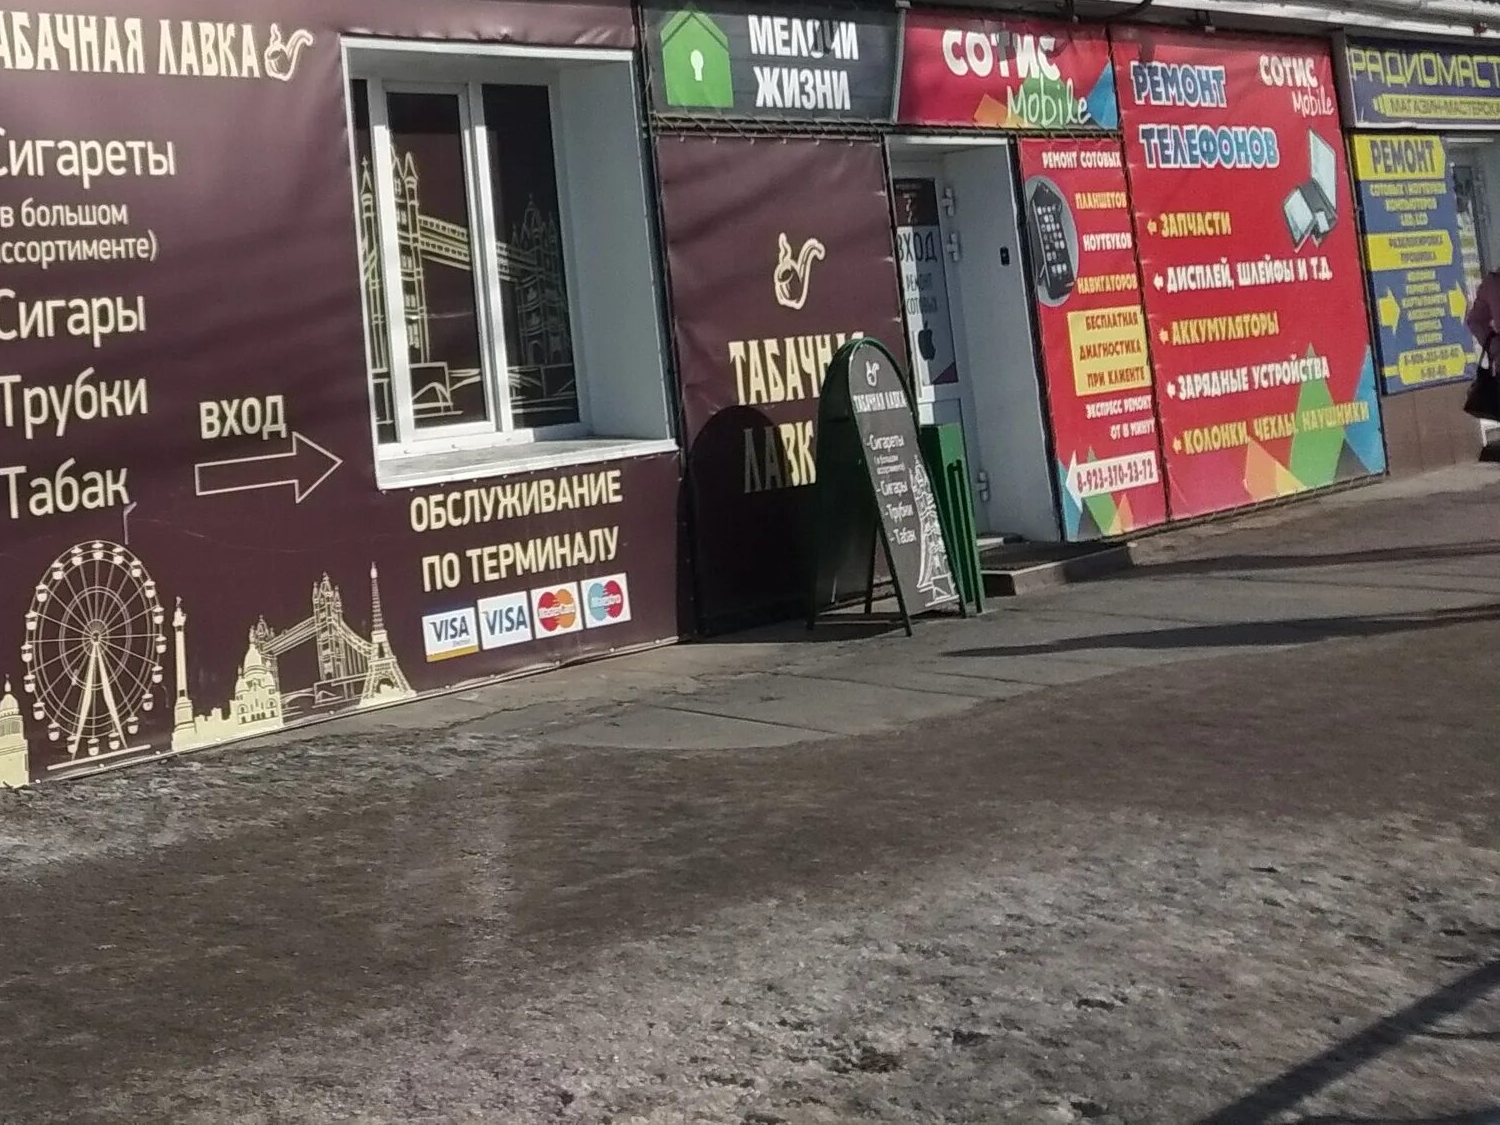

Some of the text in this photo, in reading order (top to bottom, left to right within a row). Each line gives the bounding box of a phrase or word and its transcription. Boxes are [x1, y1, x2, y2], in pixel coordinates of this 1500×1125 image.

[158, 20, 260, 78] ЛАВКА
[748, 15, 859, 60] МЕЛОЧИ
[942, 29, 1061, 81] СОТИС
[1130, 62, 1227, 108] РЕМОНТ
[1260, 54, 1318, 87] СОТИС
[1350, 48, 1500, 88] РАДИОМАСТ
[753, 66, 851, 110] ЖИЗНИ
[1006, 73, 1091, 125] Mobile
[1042, 151, 1122, 168] РЕМОНТ СОТОВЫХ
[1139, 124, 1280, 169] ТЕЛЕФОНОВ
[1370, 139, 1436, 174] РЕМОНТ
[21, 199, 128, 228] большом
[1075, 192, 1127, 209] ПЛАНШЕТОВ
[1083, 233, 1132, 251] НОУТБУКОВ
[1160, 212, 1231, 237] ЗАПЧАСТИ
[1077, 274, 1138, 294] НАВИГАТОРОВ
[1167, 257, 1235, 293] ДИСПЛЕЙ,
[1237, 254, 1294, 286] ШЛЕЙФЫ
[1298, 258, 1308, 281] И
[1085, 312, 1138, 331] БЕСПЛАТНАЯ
[1172, 311, 1279, 345] АККУМУЛЯТОРЫ
[728, 332, 864, 406] ТАБАЧН
[1079, 339, 1141, 362] ДИАГНОСТИКА
[1086, 372, 1104, 388] ПРИ
[1178, 354, 1330, 401] ЗАРЯДНЫЕ УСТРОЙСТВА
[1302, 401, 1369, 431] НАУШНИКИ
[744, 420, 817, 493] ЛАВК
[410, 470, 623, 532] ОБСЛУЖИВАНИЕ
[422, 525, 619, 592] ПО ТЕРМИНАЛУ
[429, 616, 470, 642] VISA
[483, 605, 528, 635] VISA
